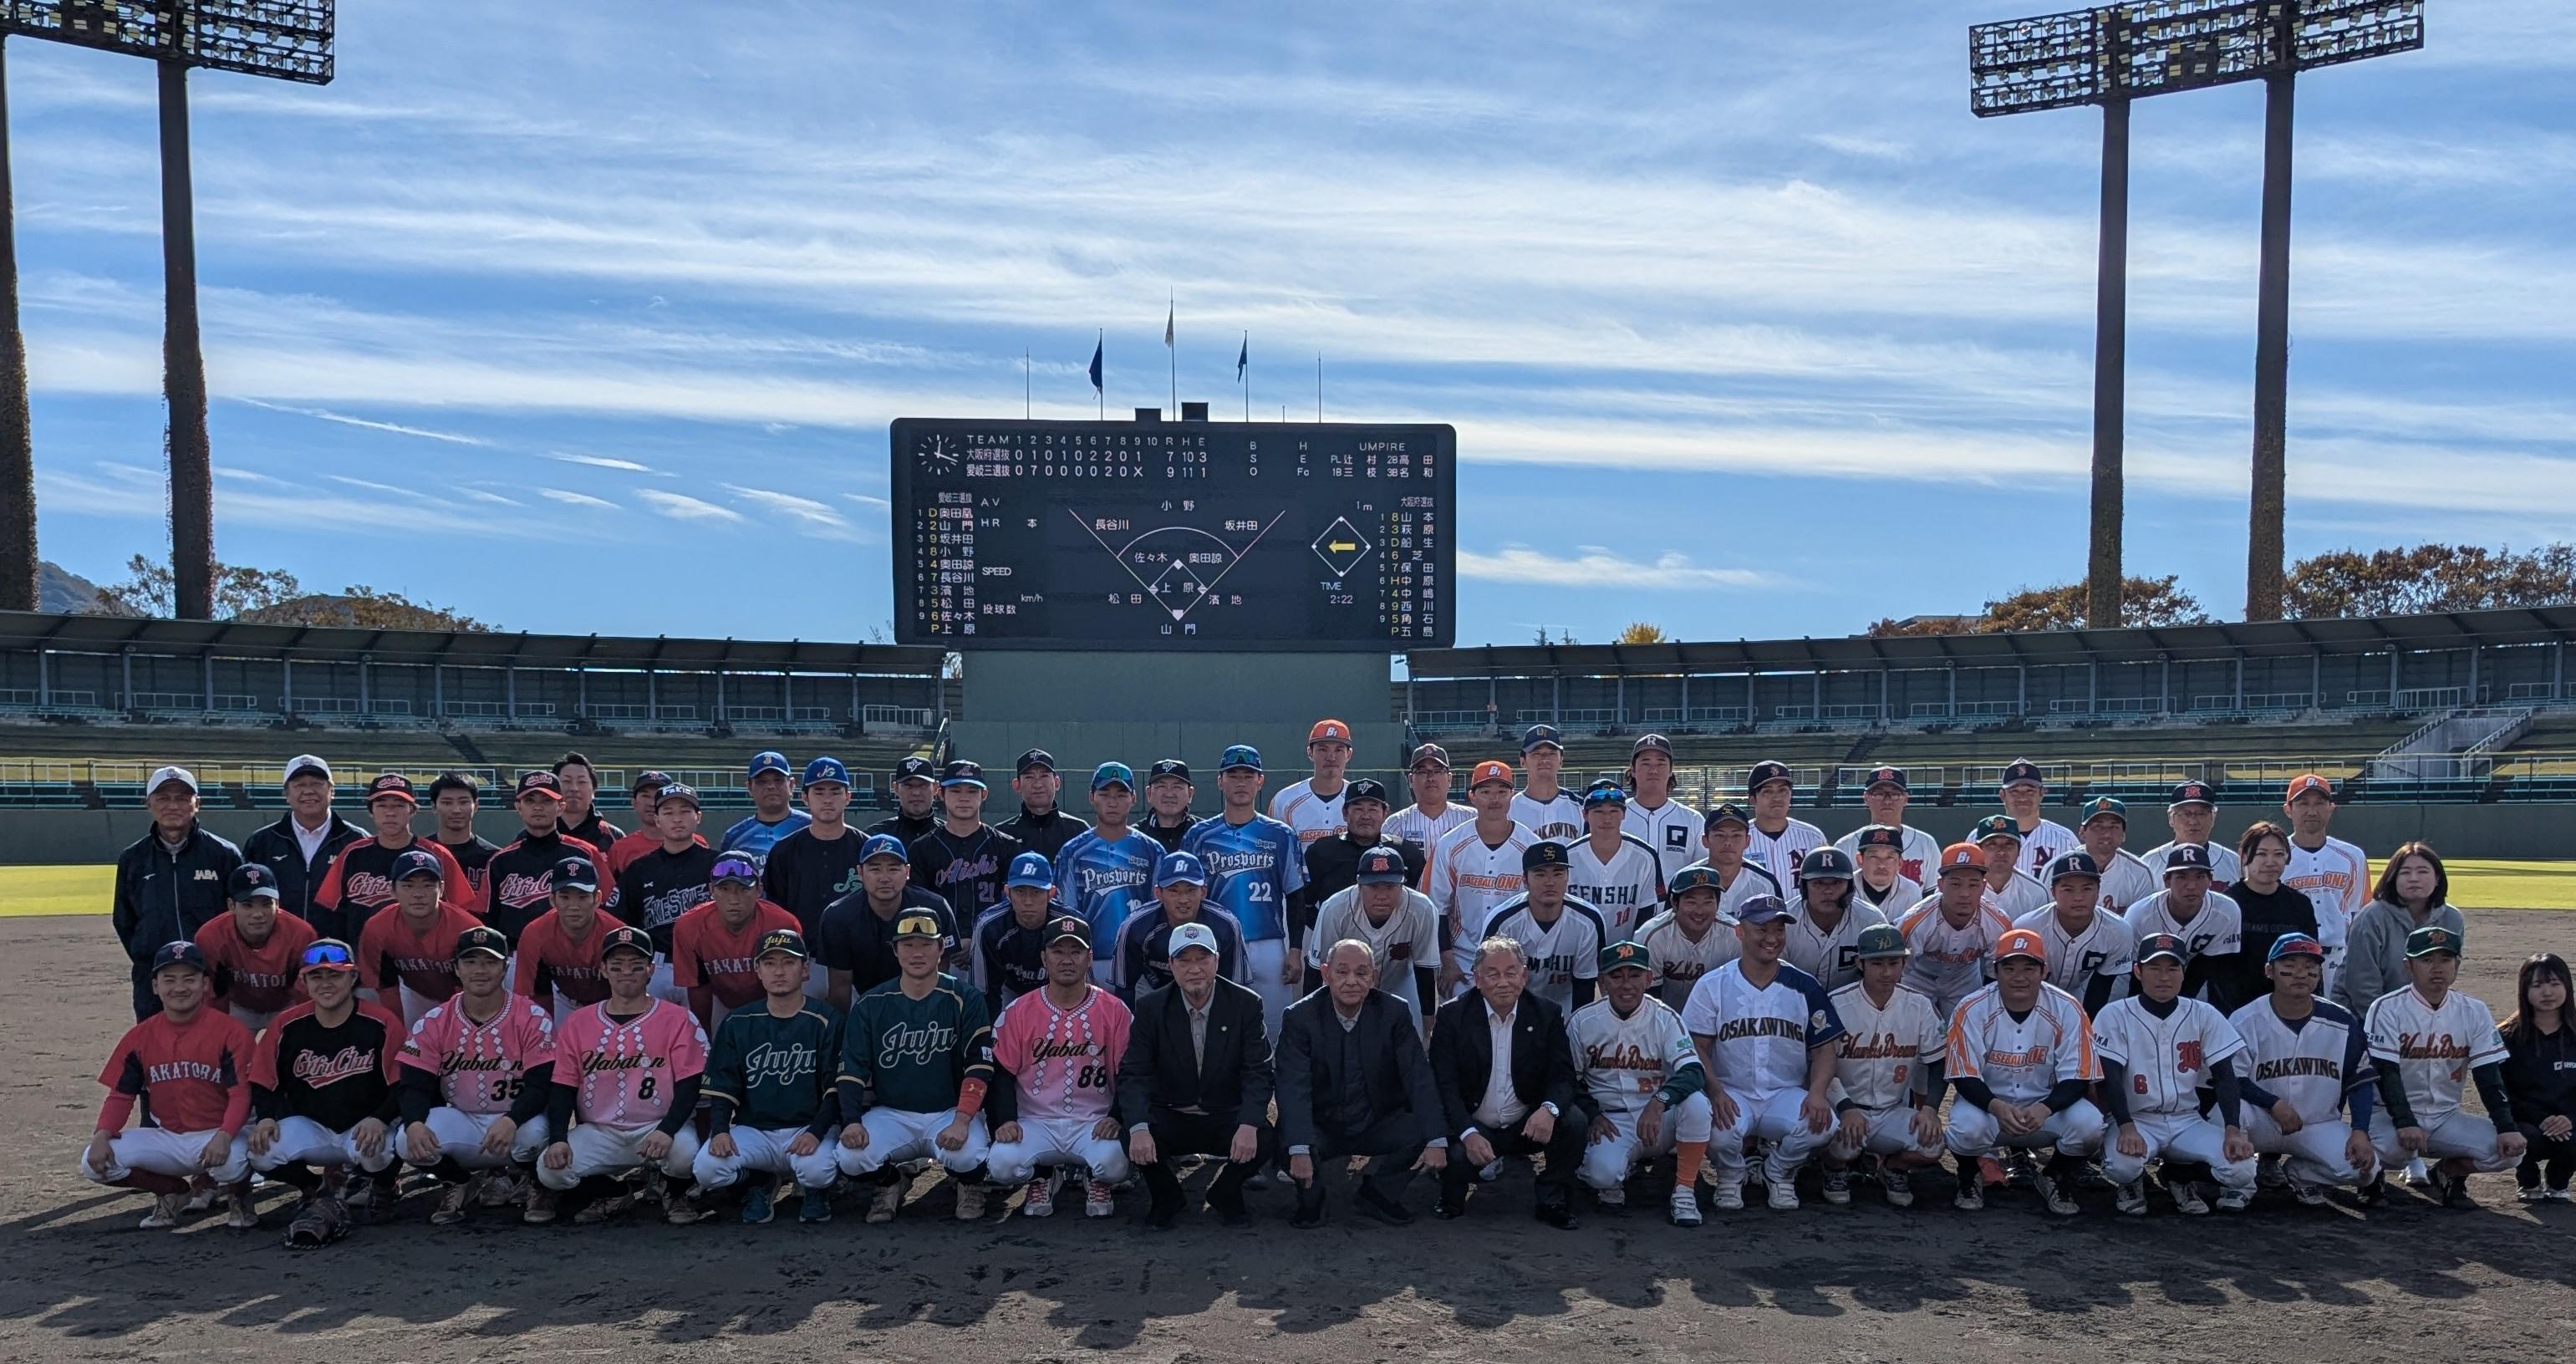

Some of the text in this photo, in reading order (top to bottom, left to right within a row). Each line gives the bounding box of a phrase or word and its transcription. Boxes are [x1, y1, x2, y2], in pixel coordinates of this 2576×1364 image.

[967, 435, 1008, 444] TEAM
[1017, 435, 1021, 444] 1
[1031, 435, 1036, 444] 2
[1076, 436, 1081, 445] 5
[1091, 436, 1096, 445] 6
[1135, 437, 1140, 445] 9
[1148, 437, 1157, 445] 10
[1183, 437, 1189, 445] H
[1199, 437, 1204, 445] E
[1250, 441, 1256, 450] B
[1300, 442, 1306, 450] H
[1016, 450, 1022, 460] 0
[1032, 450, 1036, 460] 1
[1045, 450, 1052, 461] 0
[1062, 450, 1066, 461] 1
[1075, 450, 1082, 461] 0
[1090, 450, 1097, 461] 2
[1105, 450, 1112, 461] 2
[1120, 451, 1127, 461] 0
[1137, 451, 1140, 461] 1
[1167, 451, 1173, 461] 7
[1183, 451, 1194, 462] 10
[1199, 452, 1206, 462] 3
[1301, 455, 1306, 463] E
[1331, 455, 1433, 465] PL 2B 高田
[1016, 466, 1022, 476] 0
[1031, 466, 1036, 476] 7
[1046, 466, 1052, 476] 0
[1061, 466, 1067, 476] 0
[1076, 466, 1082, 476] 0
[1090, 466, 1097, 476] 0
[1105, 466, 1112, 476] 2
[1120, 466, 1127, 476] 0
[1134, 466, 1143, 476] X
[1167, 467, 1173, 477] 9
[1183, 467, 1192, 477] 11
[1202, 467, 1205, 477] 1
[1333, 468, 1341, 476] 1B
[1387, 468, 1397, 476] 3B
[1400, 468, 1433, 477] 名和
[1162, 501, 1194, 511] 小野
[929, 508, 937, 517] D
[1392, 512, 1433, 522] 8 山本
[930, 522, 936, 530] 2
[1028, 519, 1036, 527] 本
[1096, 519, 1128, 530] 長谷川
[1225, 521, 1257, 531] 坂井田
[1392, 525, 1398, 534] 3
[929, 533, 973, 544] 9 坂井田
[1392, 538, 1399, 547] D
[930, 547, 974, 557] 8 小野
[1135, 552, 1168, 562] 佐々木
[1392, 551, 1423, 561] 6 芝
[930, 560, 937, 568] 4
[1392, 562, 1433, 573] 7 保田
[931, 573, 974, 583] 7 長谷川
[1391, 576, 1433, 586] H 中原
[931, 586, 938, 594] 3
[1161, 583, 1194, 593] 上原
[1321, 582, 1341, 590] TIME
[932, 598, 974, 608] 5 松田
[1109, 593, 1141, 603] 松田
[1331, 595, 1352, 603] 2:22
[984, 604, 1016, 614] 投球数
[1392, 601, 1433, 611] 9 西川
[932, 611, 975, 621] 6 佐々木
[1392, 614, 1433, 623] 5 角石
[932, 623, 975, 634] P 上原
[1161, 623, 1195, 634] 山門
[1392, 627, 1398, 635] P
[1326, 726, 1337, 736] B1
[1647, 737, 1656, 746] R
[1489, 766, 1501, 776] B1
[1256, 838, 1276, 848] Japan
[1821, 853, 1834, 867] R
[1957, 852, 1970, 863] B1
[2183, 849, 2196, 862] R
[1130, 855, 1149, 867] Japan
[1207, 851, 1275, 875] Prosports
[2069, 858, 2081, 871] R
[567, 863, 579, 877] T
[1021, 863, 1036, 877] B1
[1173, 860, 1188, 873] B1
[194, 870, 218, 881] JABA
[247, 870, 260, 884] T
[1082, 868, 1148, 893] Prosports
[1460, 874, 1522, 891] BASEBALL ONE
[979, 881, 995, 902] 21
[1249, 882, 1272, 902] 22
[764, 935, 792, 949] Juju
[2013, 937, 2028, 949] B1
[172, 944, 186, 959] T
[1719, 1017, 1804, 1043] OSAKAWING
[879, 1020, 958, 1068] Juju
[746, 1042, 816, 1089] Juju
[2256, 1056, 2340, 1082] OSAKAWING
[150, 1061, 221, 1084] AKATORA
[1077, 1066, 1107, 1088] 88
[1894, 1065, 1907, 1084] 8
[638, 1076, 656, 1100] 8
[2134, 1074, 2148, 1095] 6
[491, 1079, 525, 1102] 35
